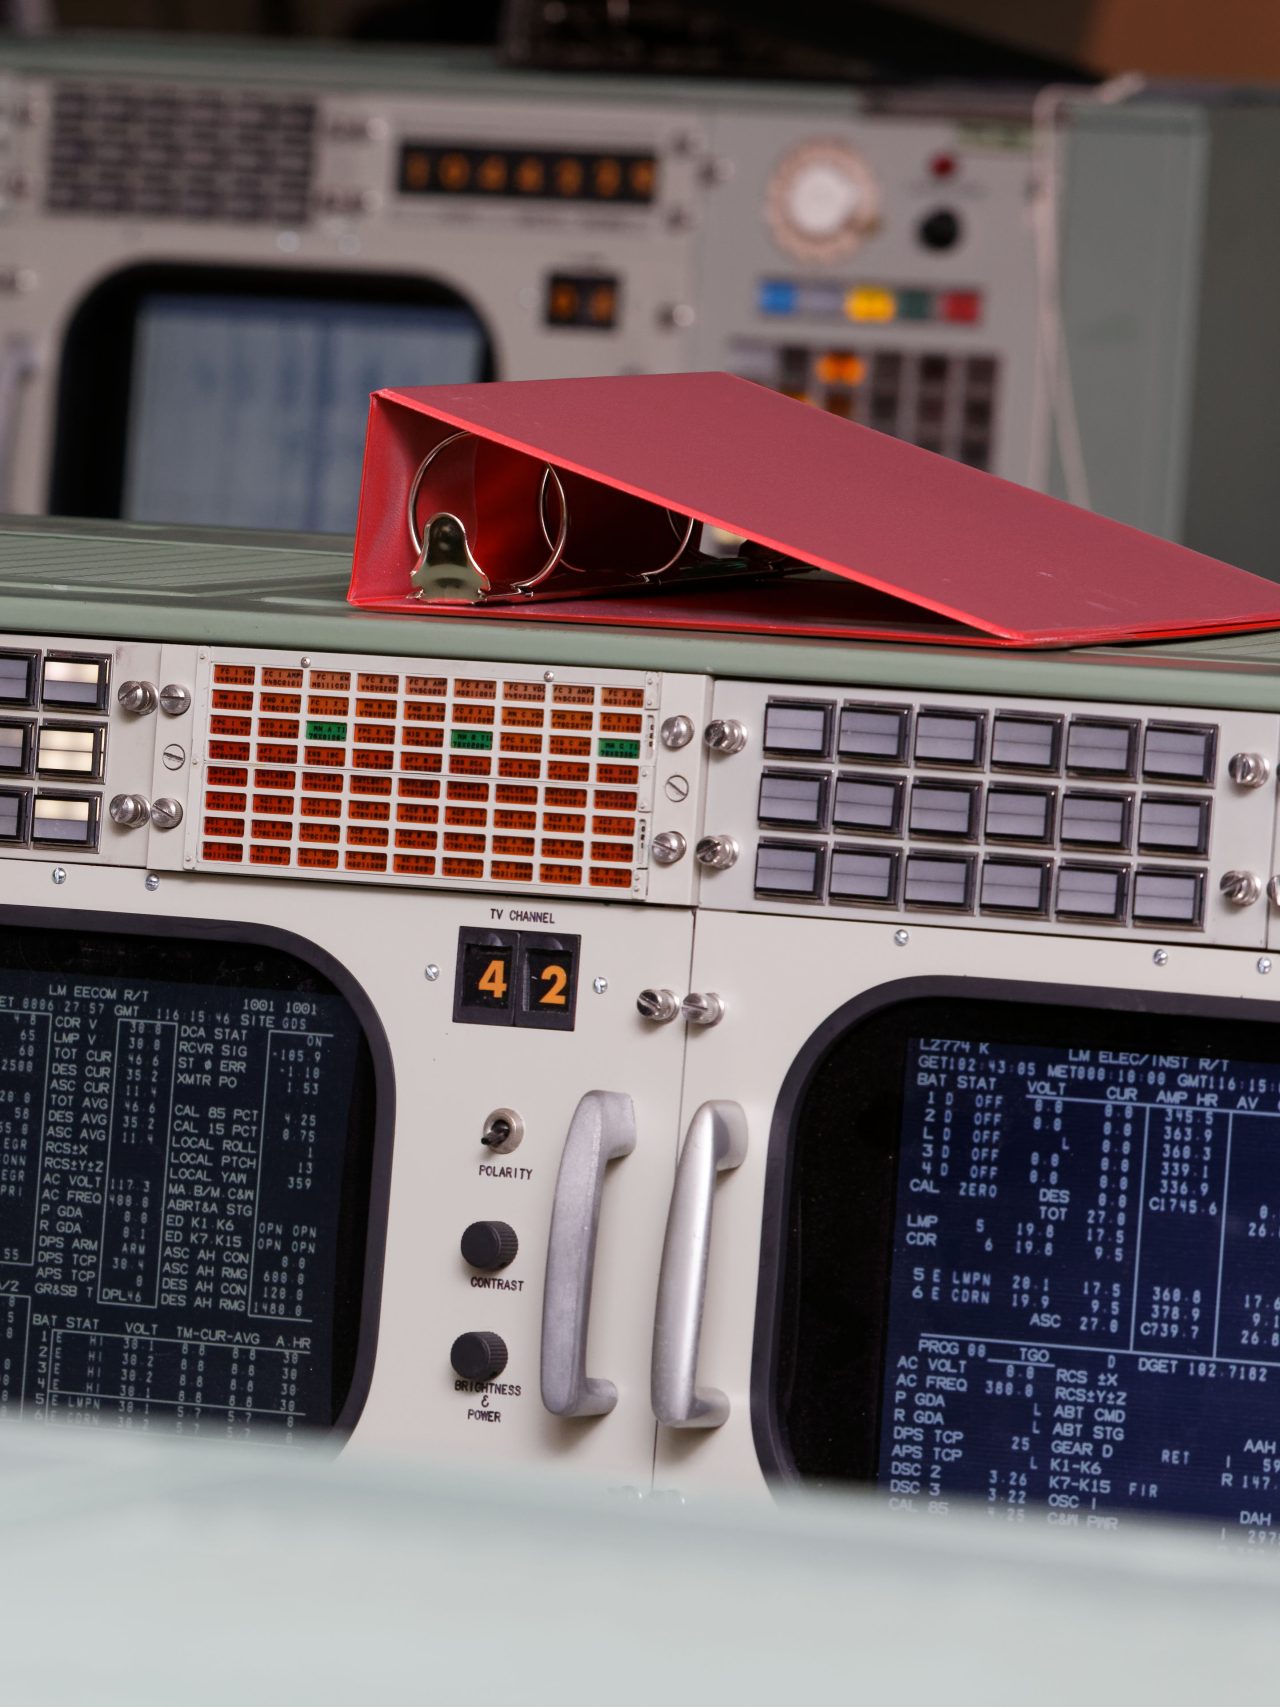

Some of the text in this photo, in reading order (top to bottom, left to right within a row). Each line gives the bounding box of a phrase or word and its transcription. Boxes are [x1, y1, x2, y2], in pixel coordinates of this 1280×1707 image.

[490, 908, 555, 924] TV CHANNEL
[478, 959, 567, 1005] 4 2
[48, 983, 149, 1003] LM EECOM R/T
[243, 998, 317, 1016] 1001 1001
[54, 1015, 81, 1029] CDR
[113, 1004, 140, 1017] GMT
[240, 1013, 276, 1029] SITE
[53, 1031, 80, 1044] LMP
[180, 1024, 248, 1041] DCA STAT
[54, 1046, 113, 1063] TOT CUR
[178, 1040, 248, 1058] RCVR SIG
[219, 1059, 247, 1074] ERR
[1068, 1048, 1091, 1062] LM
[1198, 1057, 1229, 1072] R/T
[51, 1062, 111, 1079] DES CUR
[176, 1072, 238, 1089] XMTR PO
[916, 1071, 1259, 1110] BAT STAT VOLT CUR AMP HR AV
[975, 1093, 1004, 1109] OFF
[174, 1103, 259, 1122] CAL 85 PCT
[973, 1111, 1002, 1126] OFF
[171, 1135, 257, 1154] LOCAL ROLL
[170, 1151, 257, 1169] LOCAL PTCH
[42, 1172, 102, 1189] AC VOLT
[169, 1167, 247, 1185] LOCAL YAW
[479, 1164, 533, 1180] POLARITY
[41, 1188, 103, 1205] AC FREQ
[909, 1178, 1070, 1204] CAL ZERO DES
[226, 1203, 253, 1217] STG
[1039, 1205, 1068, 1221] TOT
[906, 1213, 939, 1229] LMP
[38, 1234, 99, 1251] DPS ARM
[905, 1231, 938, 1247] CDR
[37, 1250, 97, 1267] DPS TCP
[162, 1261, 248, 1281] ASC AH RMG
[952, 1271, 991, 1287] LMPN
[161, 1276, 247, 1297] DES AH CON
[470, 1276, 524, 1291] CONTRAST
[951, 1288, 990, 1305] CDRN
[32, 1313, 58, 1327] BAT
[65, 1316, 100, 1330] STAT
[124, 1321, 159, 1336] VOLT
[1029, 1312, 1062, 1329] ASC
[918, 1338, 1179, 1374] PROG TGO DGET
[454, 1380, 522, 1396] BRIGHTNESS
[895, 1372, 968, 1392] AC FREQ
[914, 1392, 946, 1408] GDA
[467, 1408, 501, 1422] POWER
[1053, 1404, 1126, 1424] ABT CMD
[893, 1425, 964, 1445] DPS TCP
[1052, 1421, 1125, 1442] ABT STG
[1050, 1439, 1190, 1465] GEAR RET
[890, 1460, 922, 1477] DSC
[1047, 1493, 1082, 1510] OSC
[1240, 1511, 1271, 1526] DAH
